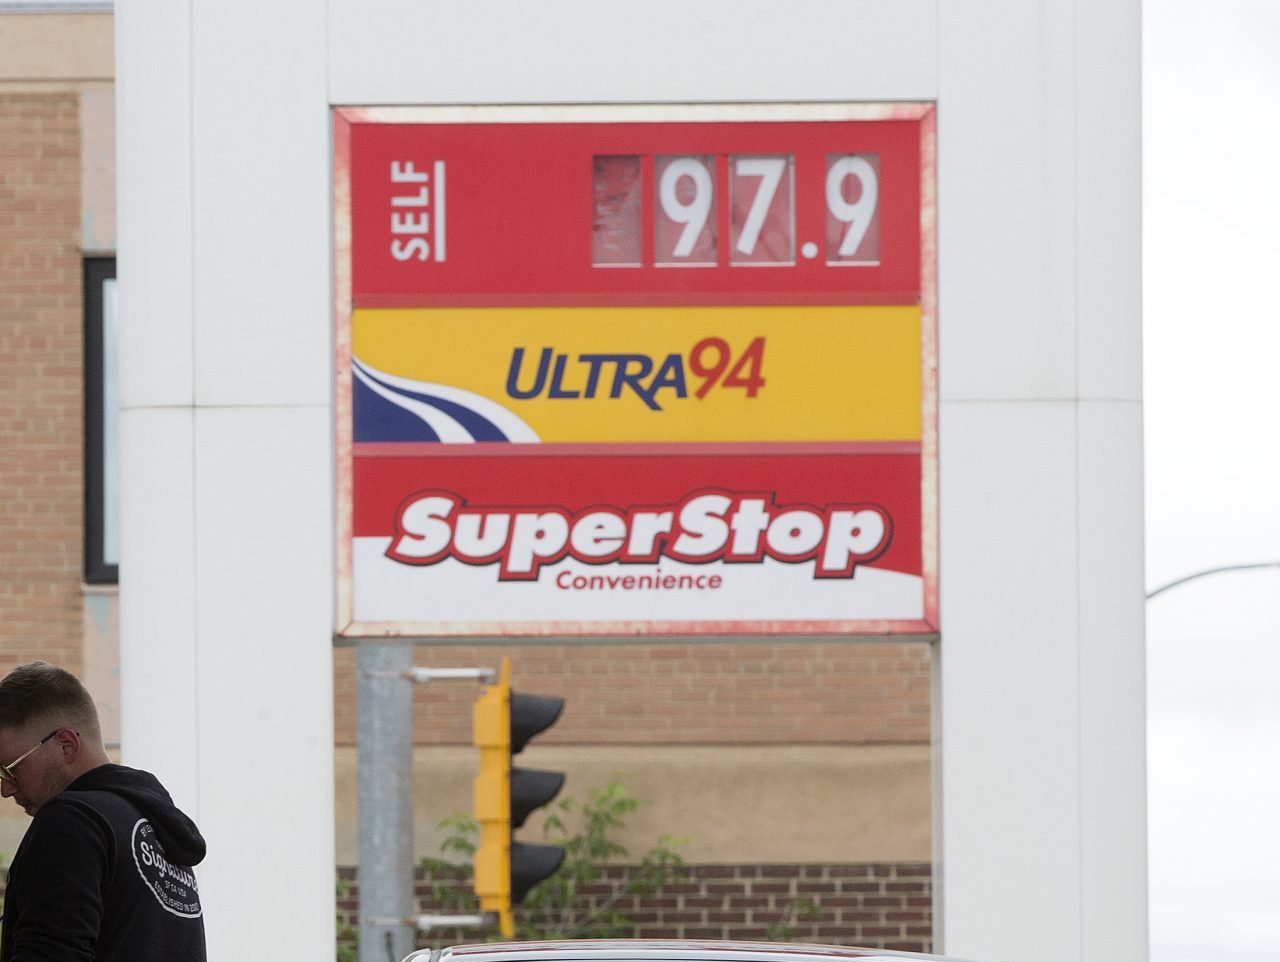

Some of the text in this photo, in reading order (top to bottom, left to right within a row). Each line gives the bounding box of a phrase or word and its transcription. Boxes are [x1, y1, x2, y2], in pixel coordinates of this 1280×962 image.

[391, 160, 429, 261] SELF
[658, 157, 879, 259] 97.9
[388, 492, 890, 578] SuperStop
[555, 568, 724, 591] Convenience
